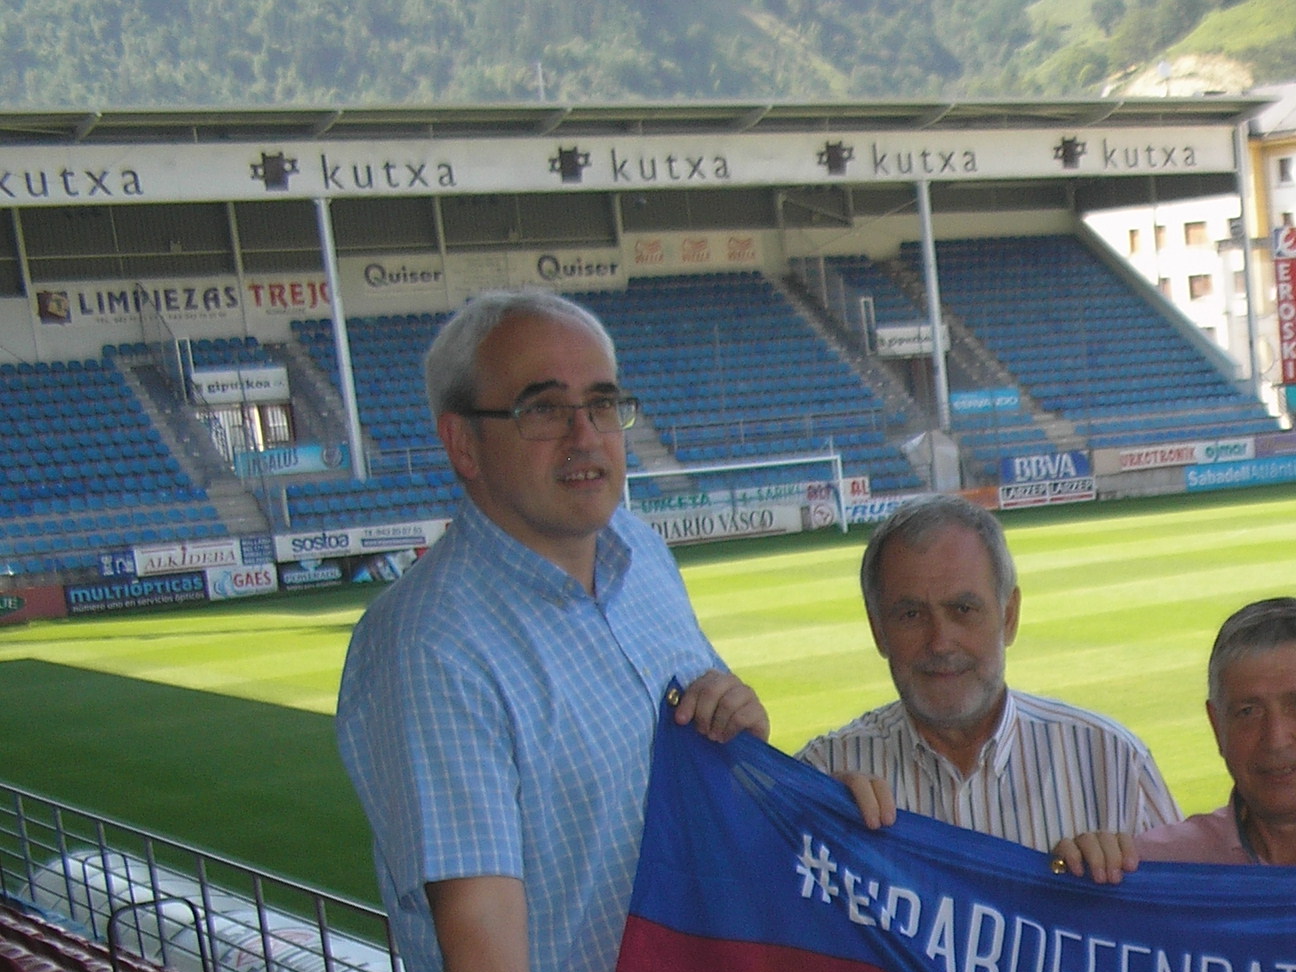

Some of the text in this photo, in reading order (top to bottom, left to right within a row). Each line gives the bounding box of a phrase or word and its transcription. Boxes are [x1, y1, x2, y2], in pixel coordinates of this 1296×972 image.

[611, 148, 731, 182] kutxa
[872, 143, 979, 176] kutxa
[1103, 138, 1198, 169] kutxa
[321, 154, 457, 190] kutxa
[78, 285, 240, 315] LIMPIEZAS
[1277, 263, 1296, 379] EROSKI
[1014, 452, 1077, 482] BBVA
[1188, 466, 1250, 487] Sabadell
[718, 508, 774, 532] VASCO
[291, 533, 349, 553] sostoa
[233, 571, 272, 589] GAES
